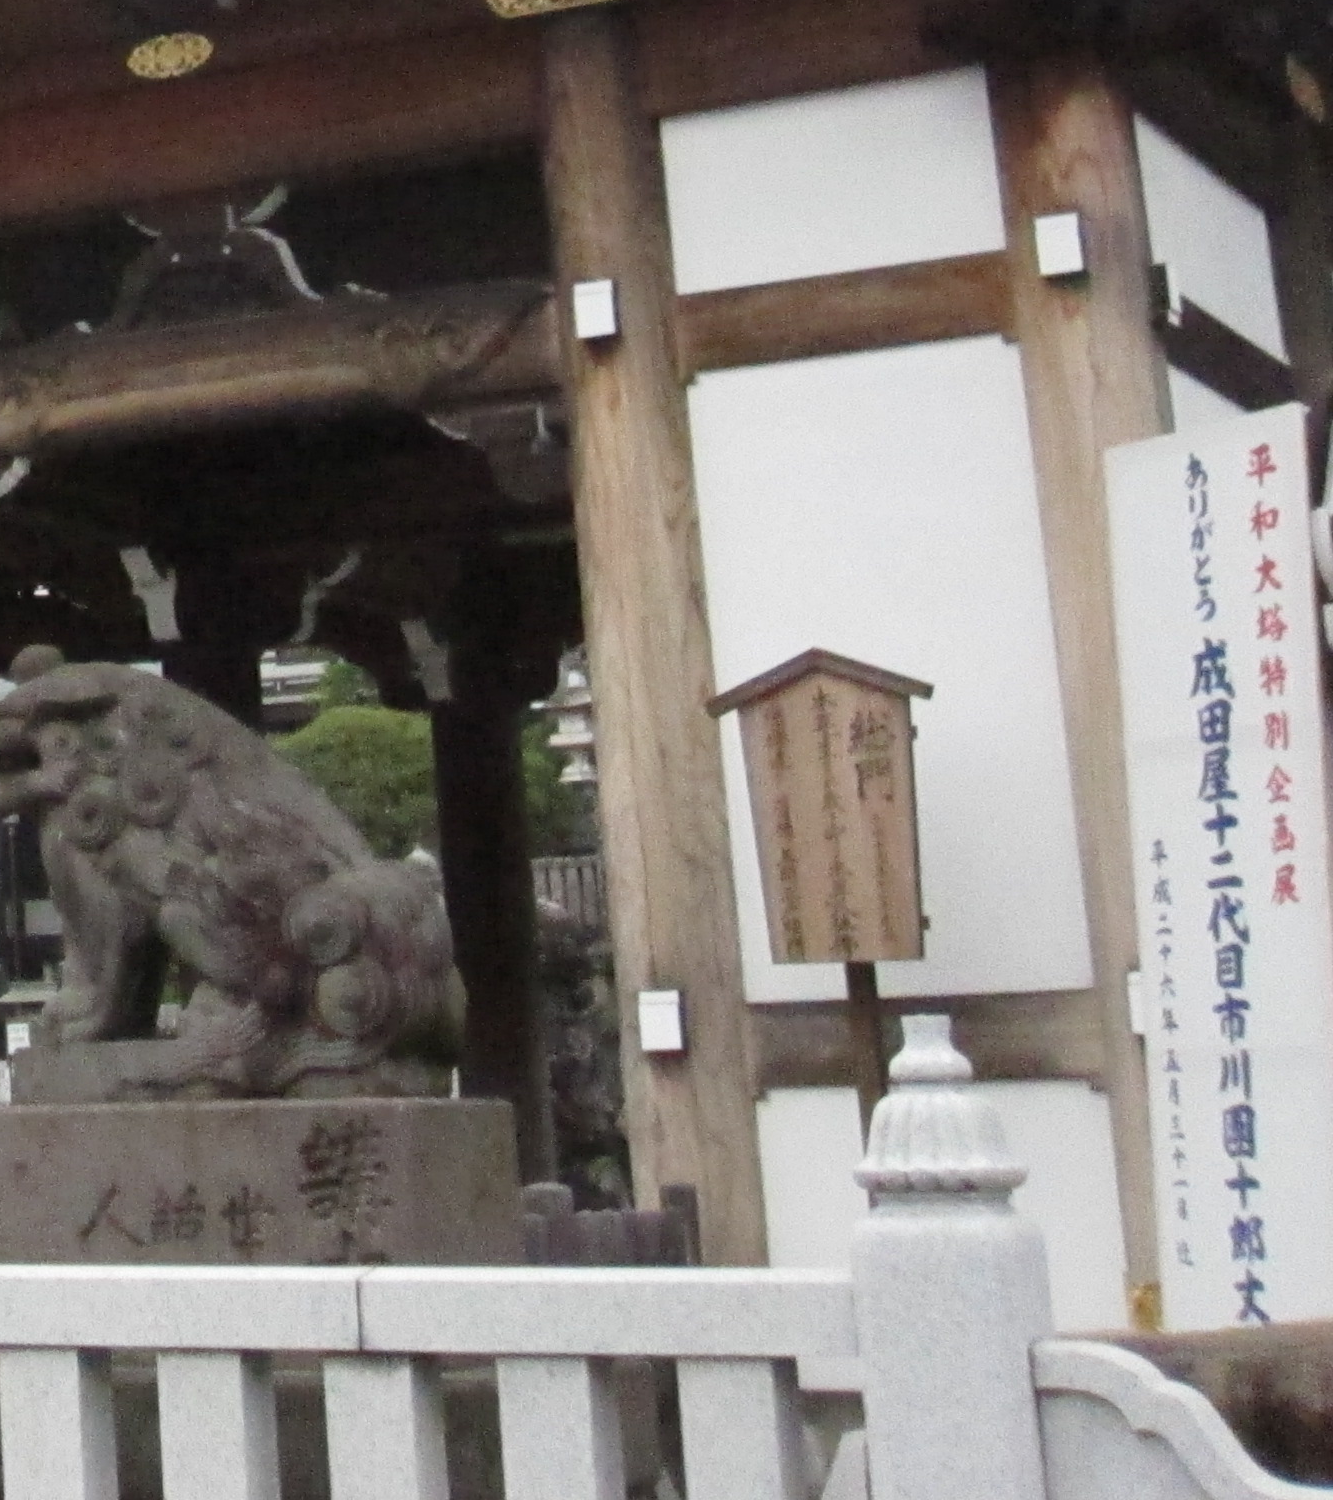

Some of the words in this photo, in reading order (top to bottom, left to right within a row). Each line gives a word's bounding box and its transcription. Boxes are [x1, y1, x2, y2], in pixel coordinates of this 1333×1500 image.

[1185, 453, 1217, 622] ありがとう
[1246, 442, 1300, 904] 平和大塔特別企画展
